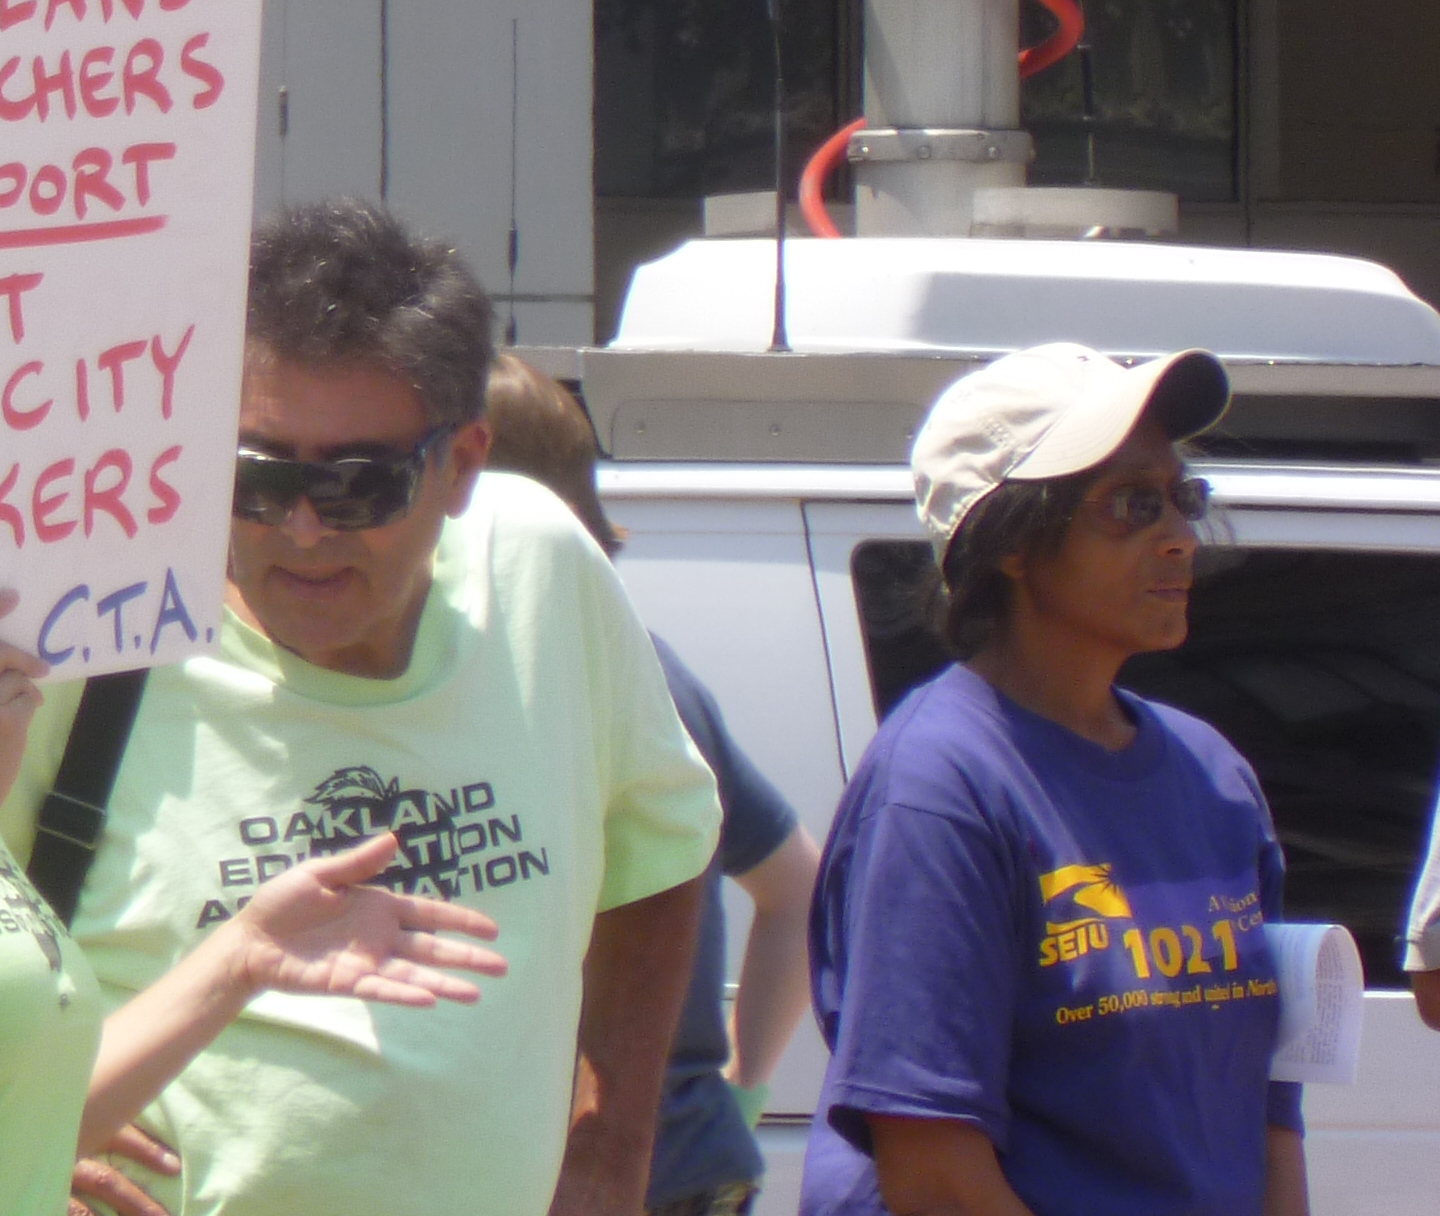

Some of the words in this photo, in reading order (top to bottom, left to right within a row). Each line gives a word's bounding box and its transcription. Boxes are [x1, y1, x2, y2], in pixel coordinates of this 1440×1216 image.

[1, 322, 197, 432] CITY
[37, 566, 215, 667] C.T.A.
[238, 781, 496, 847] OAKLAND
[1037, 922, 1110, 968] SEIU
[1122, 919, 1239, 980] 1021
[1056, 1003, 1094, 1026] Over
[1097, 988, 1149, 1017] 50,000
